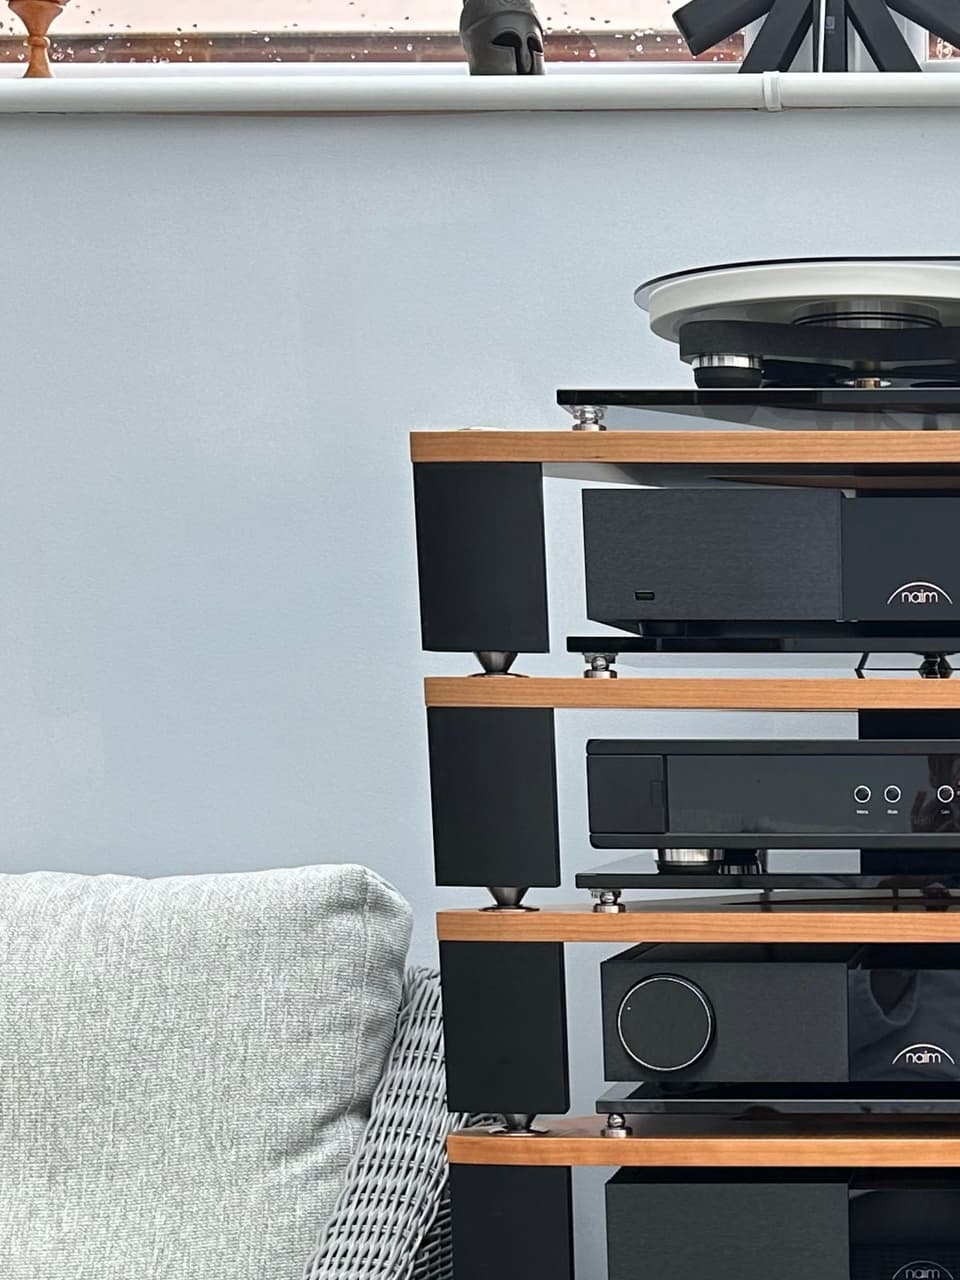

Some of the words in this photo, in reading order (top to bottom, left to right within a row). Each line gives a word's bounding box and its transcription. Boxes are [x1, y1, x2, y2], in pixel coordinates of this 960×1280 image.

[902, 589, 938, 603] naim
[906, 1050, 941, 1063] naim
[905, 1266, 940, 1279] naim
